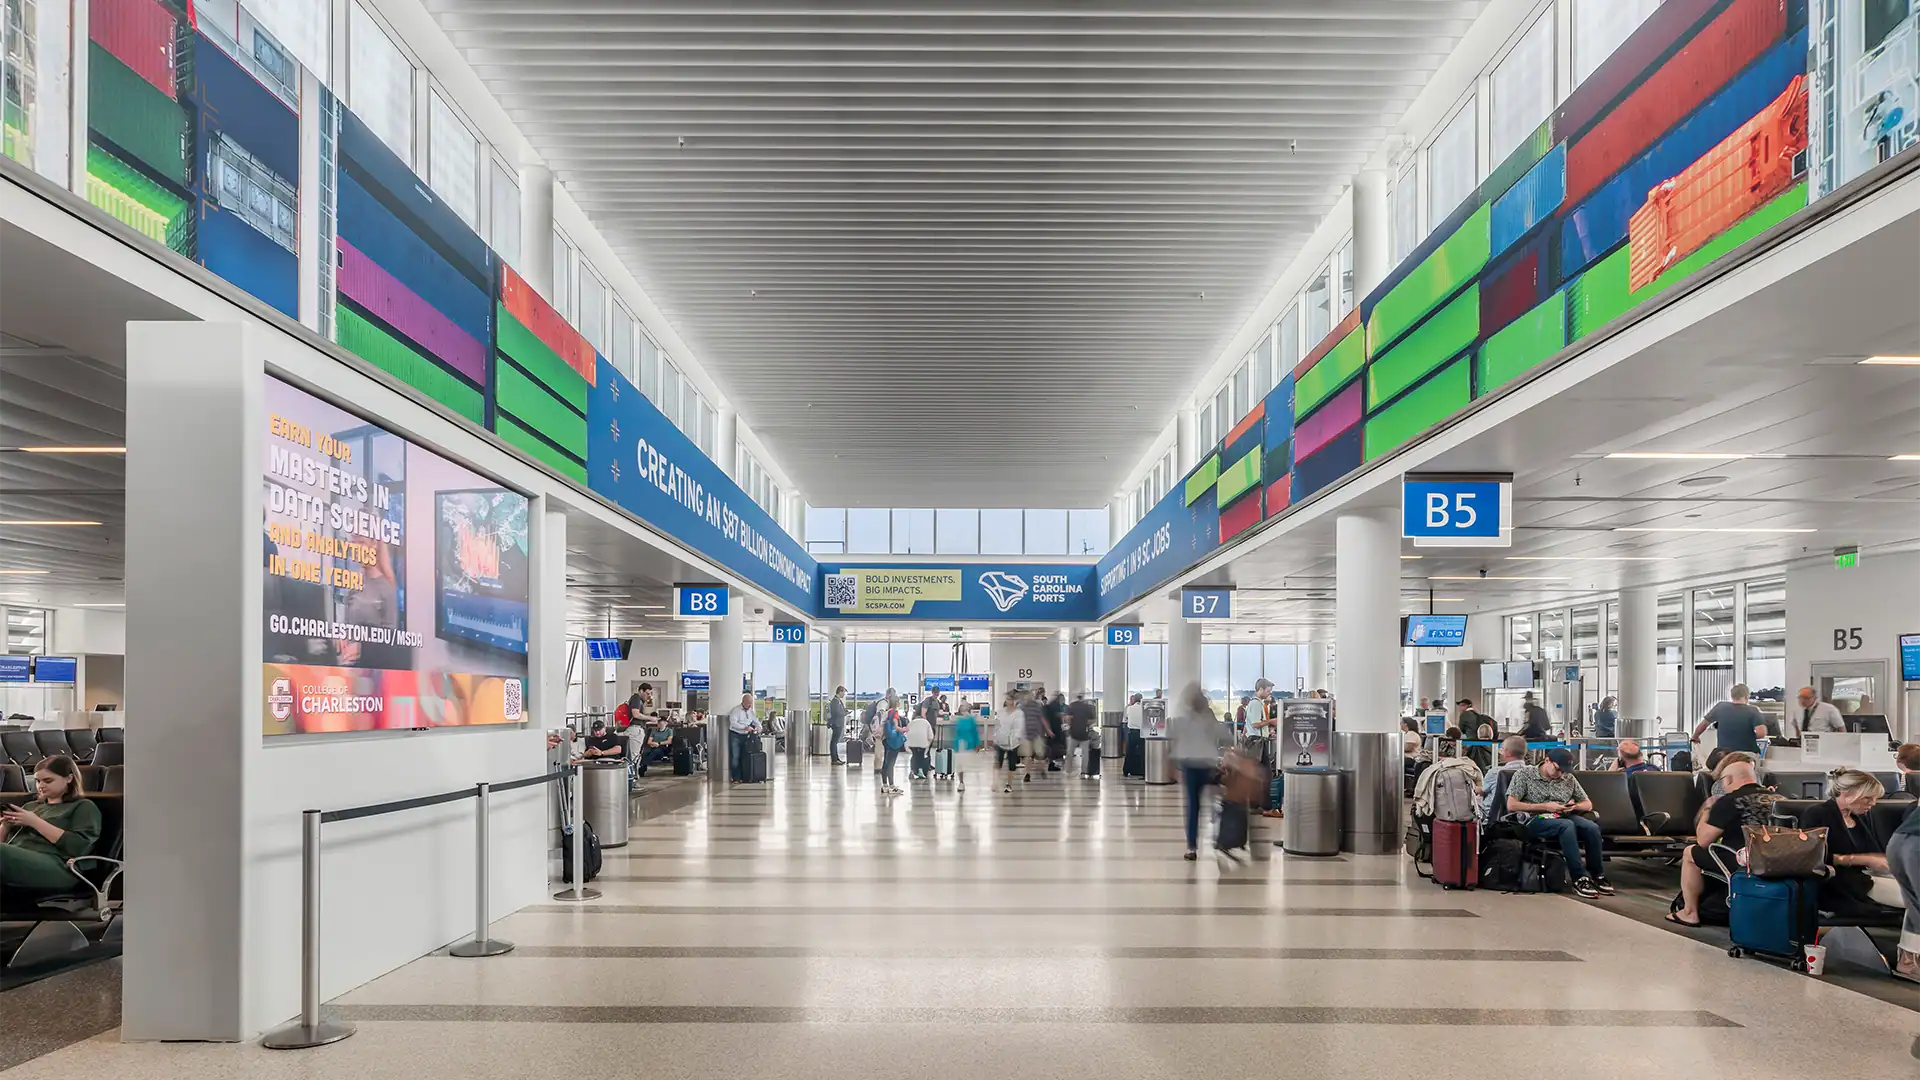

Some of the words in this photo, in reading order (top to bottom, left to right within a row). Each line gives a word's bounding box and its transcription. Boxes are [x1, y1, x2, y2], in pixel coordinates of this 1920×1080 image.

[270, 412, 311, 448] EARN
[316, 431, 352, 464] YOUR
[271, 444, 368, 502] MASTER'S
[373, 483, 389, 511] IN
[270, 483, 324, 525] DATA
[330, 503, 401, 547] SCIENCE
[637, 438, 703, 516] CREATING
[706, 493, 720, 530] AN
[722, 502, 739, 542] $87
[740, 520, 768, 564] BILLION
[769, 543, 795, 584] ECONOMIC
[796, 565, 811, 595] IMPACT
[1426, 492, 1477, 528] B5
[269, 522, 302, 549] AND
[306, 532, 377, 567] ANALYTICS
[1100, 558, 1126, 597] SUPPORTING
[1127, 555, 1130, 577] 1
[1130, 549, 1137, 575] IN
[1137, 546, 1142, 570] 9
[1142, 538, 1151, 566] SC
[1151, 521, 1170, 560] JOBS
[269, 554, 286, 577] IN
[290, 560, 321, 583] ONE
[325, 565, 364, 591] YEAR!
[865, 575, 890, 584] BOLD
[892, 575, 956, 584] INVESTMENTS.
[1032, 575, 1068, 583] SOUTH
[865, 586, 881, 595] BIG
[882, 586, 923, 595] IMPACTS.
[1032, 585, 1083, 593] CAROLINA
[1032, 594, 1065, 602] PORTS
[690, 592, 718, 611] B8
[1193, 595, 1219, 614] B7
[270, 614, 423, 648] GO.CHARLESTON.EDU/MSDA
[775, 628, 802, 641] B10
[1114, 630, 1133, 643] B9
[1833, 627, 1863, 651] B5
[640, 667, 659, 677] B10
[1018, 668, 1033, 679] B9
[302, 684, 337, 695] COLLEGE
[339, 685, 349, 695] OF
[302, 696, 384, 713] CHARLESTON
